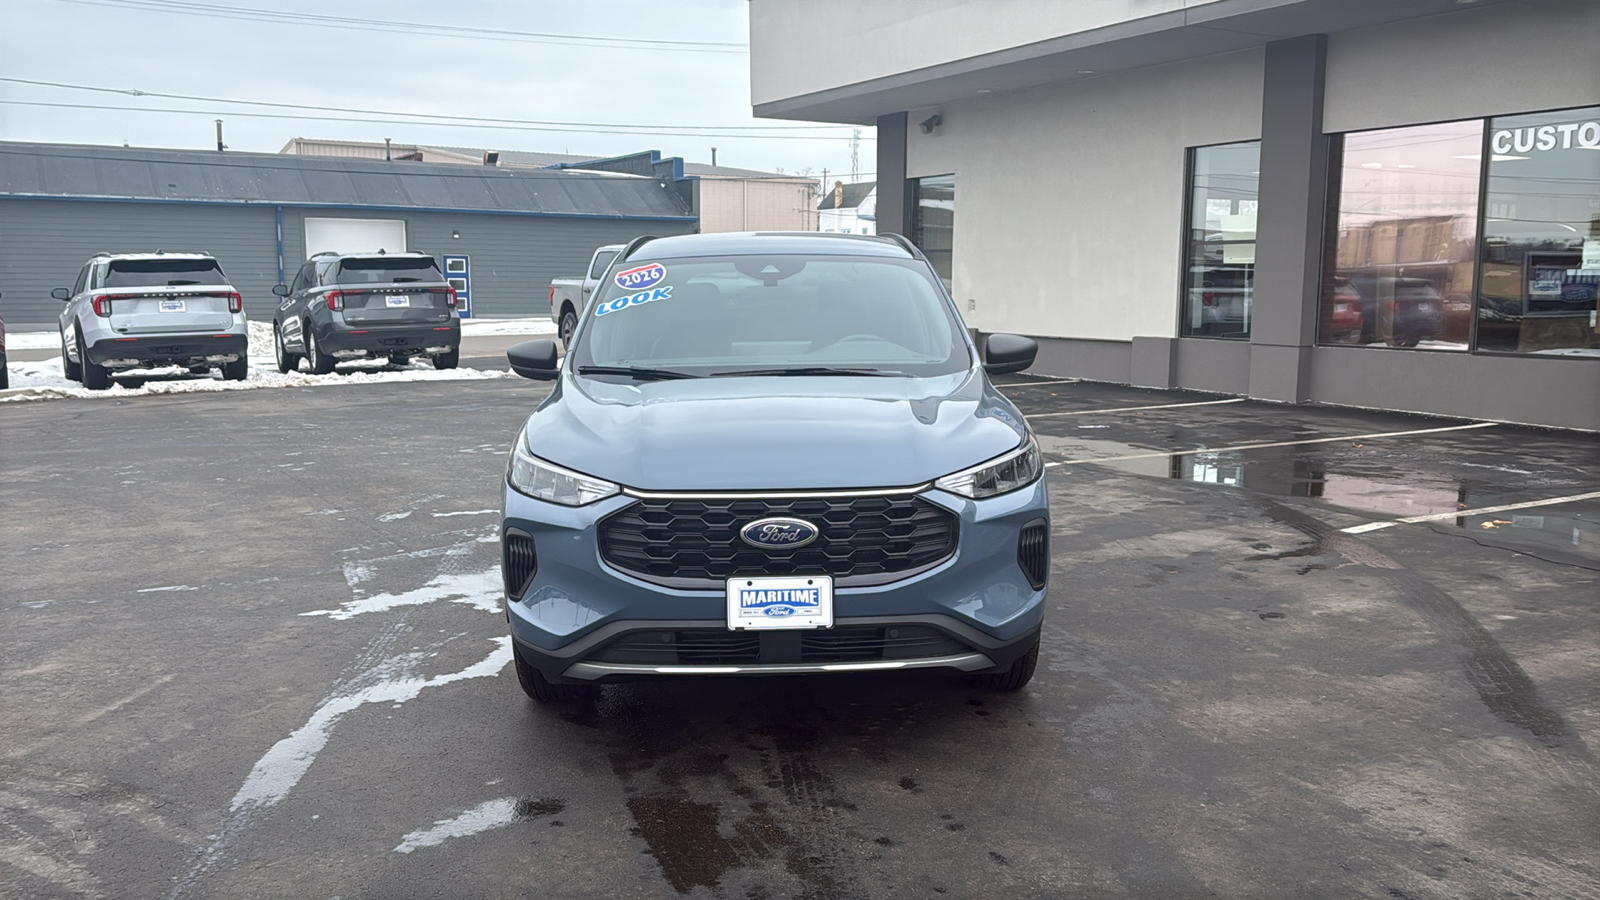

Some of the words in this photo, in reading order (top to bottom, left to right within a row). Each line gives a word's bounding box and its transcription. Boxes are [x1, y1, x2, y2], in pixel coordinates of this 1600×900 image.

[1492, 122, 1600, 154] CUSTO
[622, 268, 660, 286] 2026
[596, 287, 672, 315] LOOK
[759, 524, 801, 542] Ford
[742, 590, 818, 607] MARITIME
[768, 607, 790, 616] Ford
